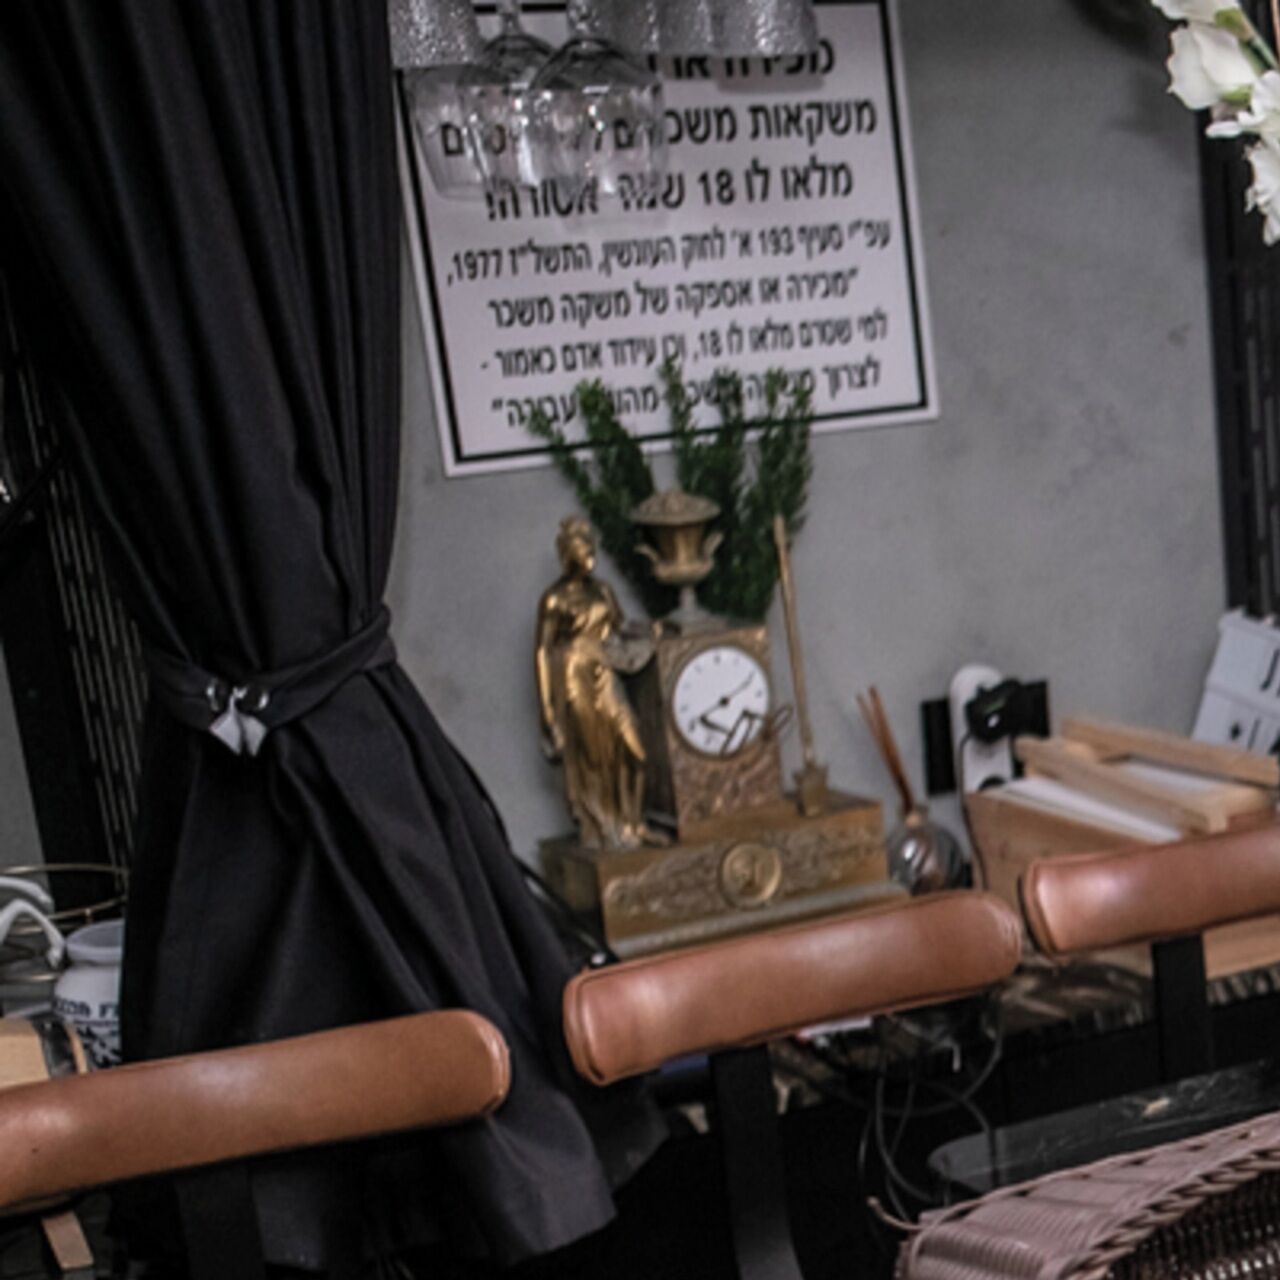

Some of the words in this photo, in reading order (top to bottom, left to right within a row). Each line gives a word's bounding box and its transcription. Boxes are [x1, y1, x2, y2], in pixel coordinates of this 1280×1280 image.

[748, 100, 876, 146] משקאות
[697, 168, 735, 205] 18
[745, 157, 770, 204] לו
[781, 153, 853, 199] מלאו
[487, 296, 555, 328] משכר
[560, 289, 632, 329] משקה
[633, 279, 669, 315] של
[674, 277, 752, 319] אספקה
